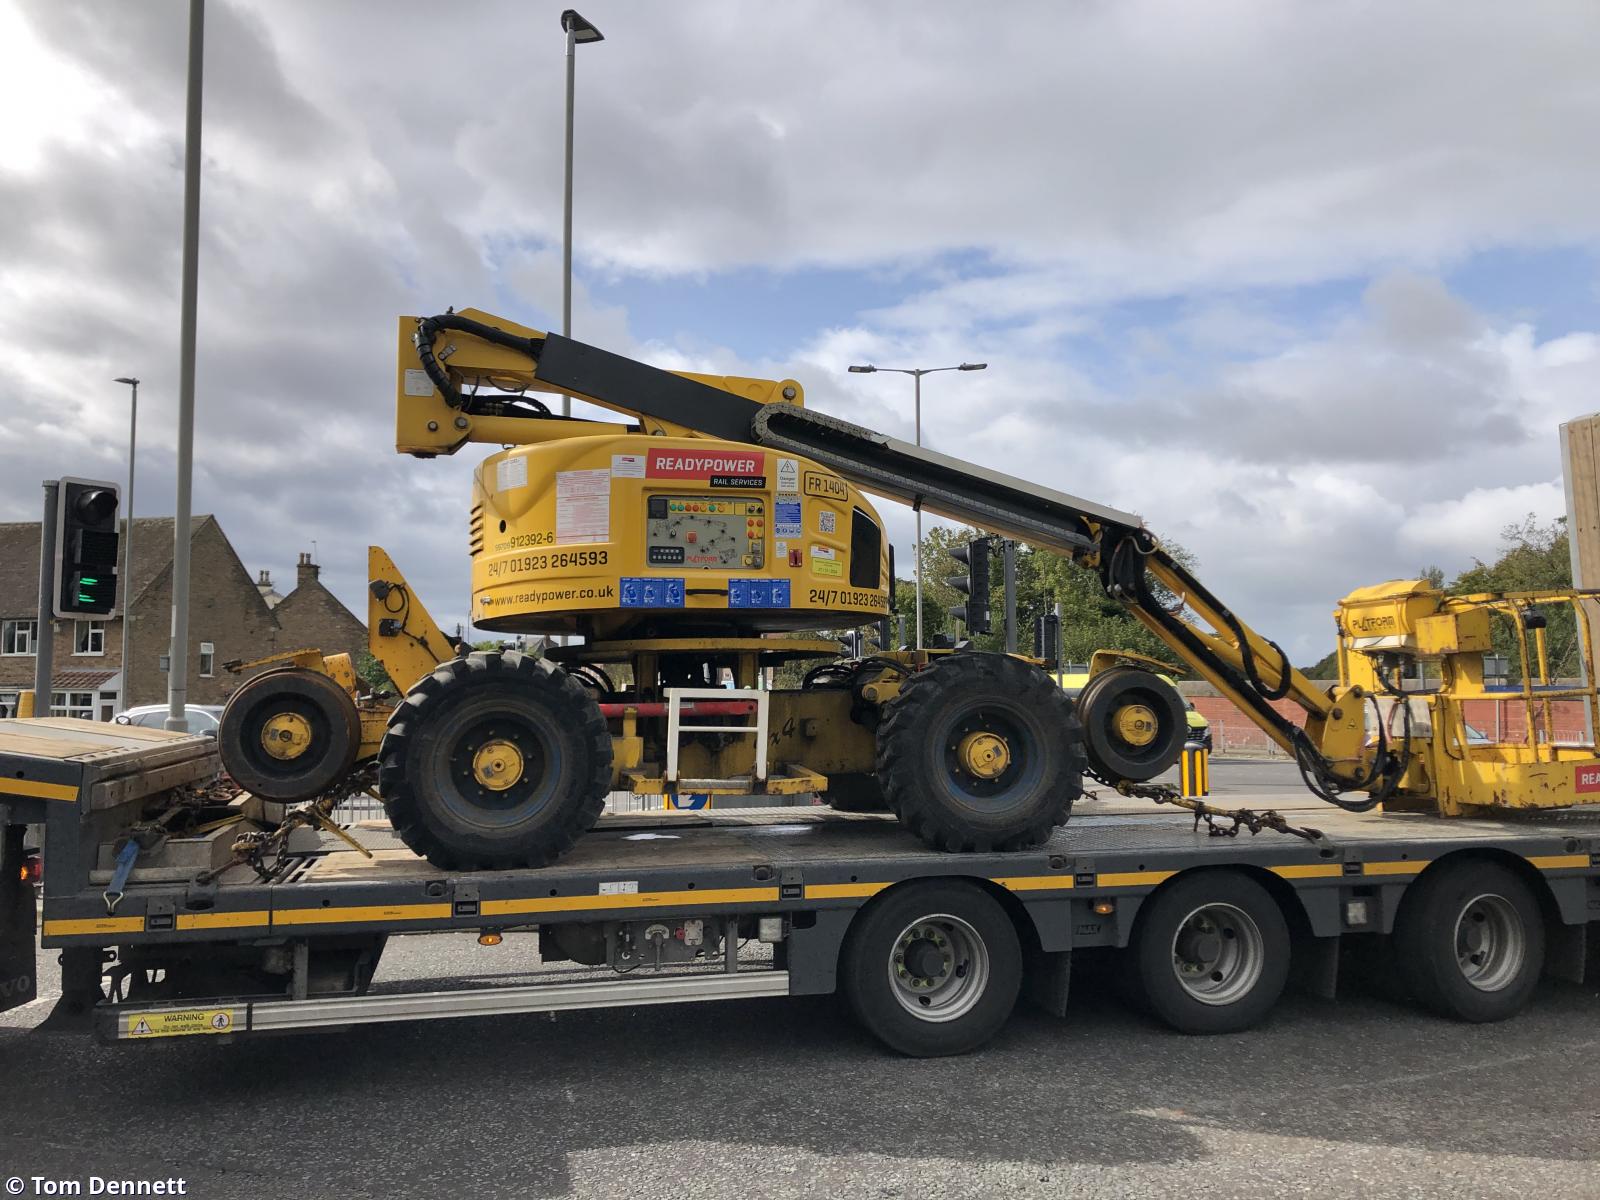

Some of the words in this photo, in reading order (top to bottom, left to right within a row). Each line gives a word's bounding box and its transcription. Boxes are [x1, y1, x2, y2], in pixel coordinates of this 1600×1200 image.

[655, 457, 755, 473] READYPOWER
[730, 478, 763, 486] SERVICES
[808, 477, 821, 492] FR
[823, 479, 845, 496] 1404
[510, 531, 554, 549] 912392-6
[488, 560, 508, 577] 24/7
[510, 555, 547, 573] 01923
[551, 551, 608, 568] 264593
[494, 585, 614, 606] www.readypower.co.uk
[809, 589, 838, 606] 24/7
[840, 590, 868, 606] 01923
[163, 1013, 205, 1023] WARNING
